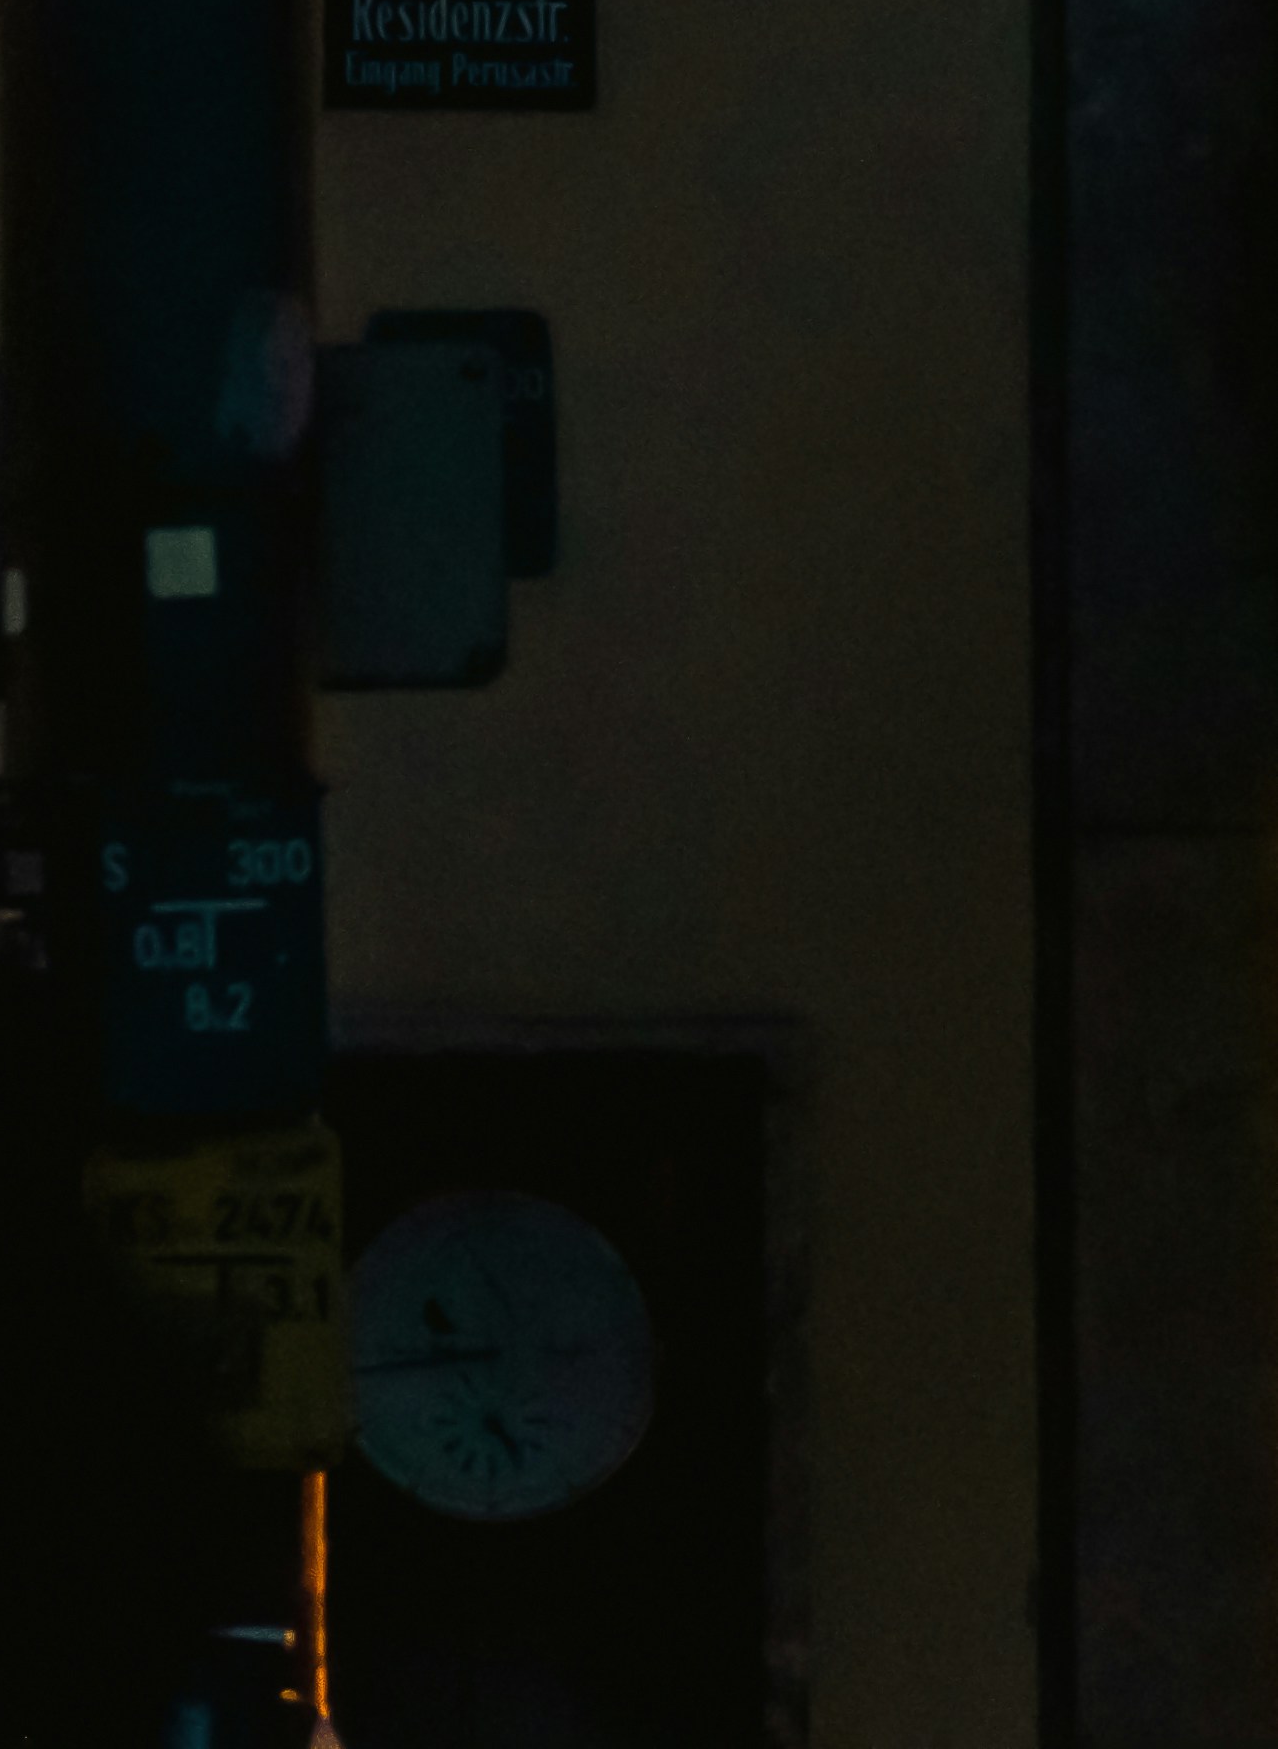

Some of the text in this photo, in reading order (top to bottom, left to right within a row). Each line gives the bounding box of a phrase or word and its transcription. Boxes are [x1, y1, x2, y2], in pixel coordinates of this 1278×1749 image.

[100, 840, 131, 893] S
[226, 837, 313, 888] 300
[213, 1191, 333, 1242] 2474
